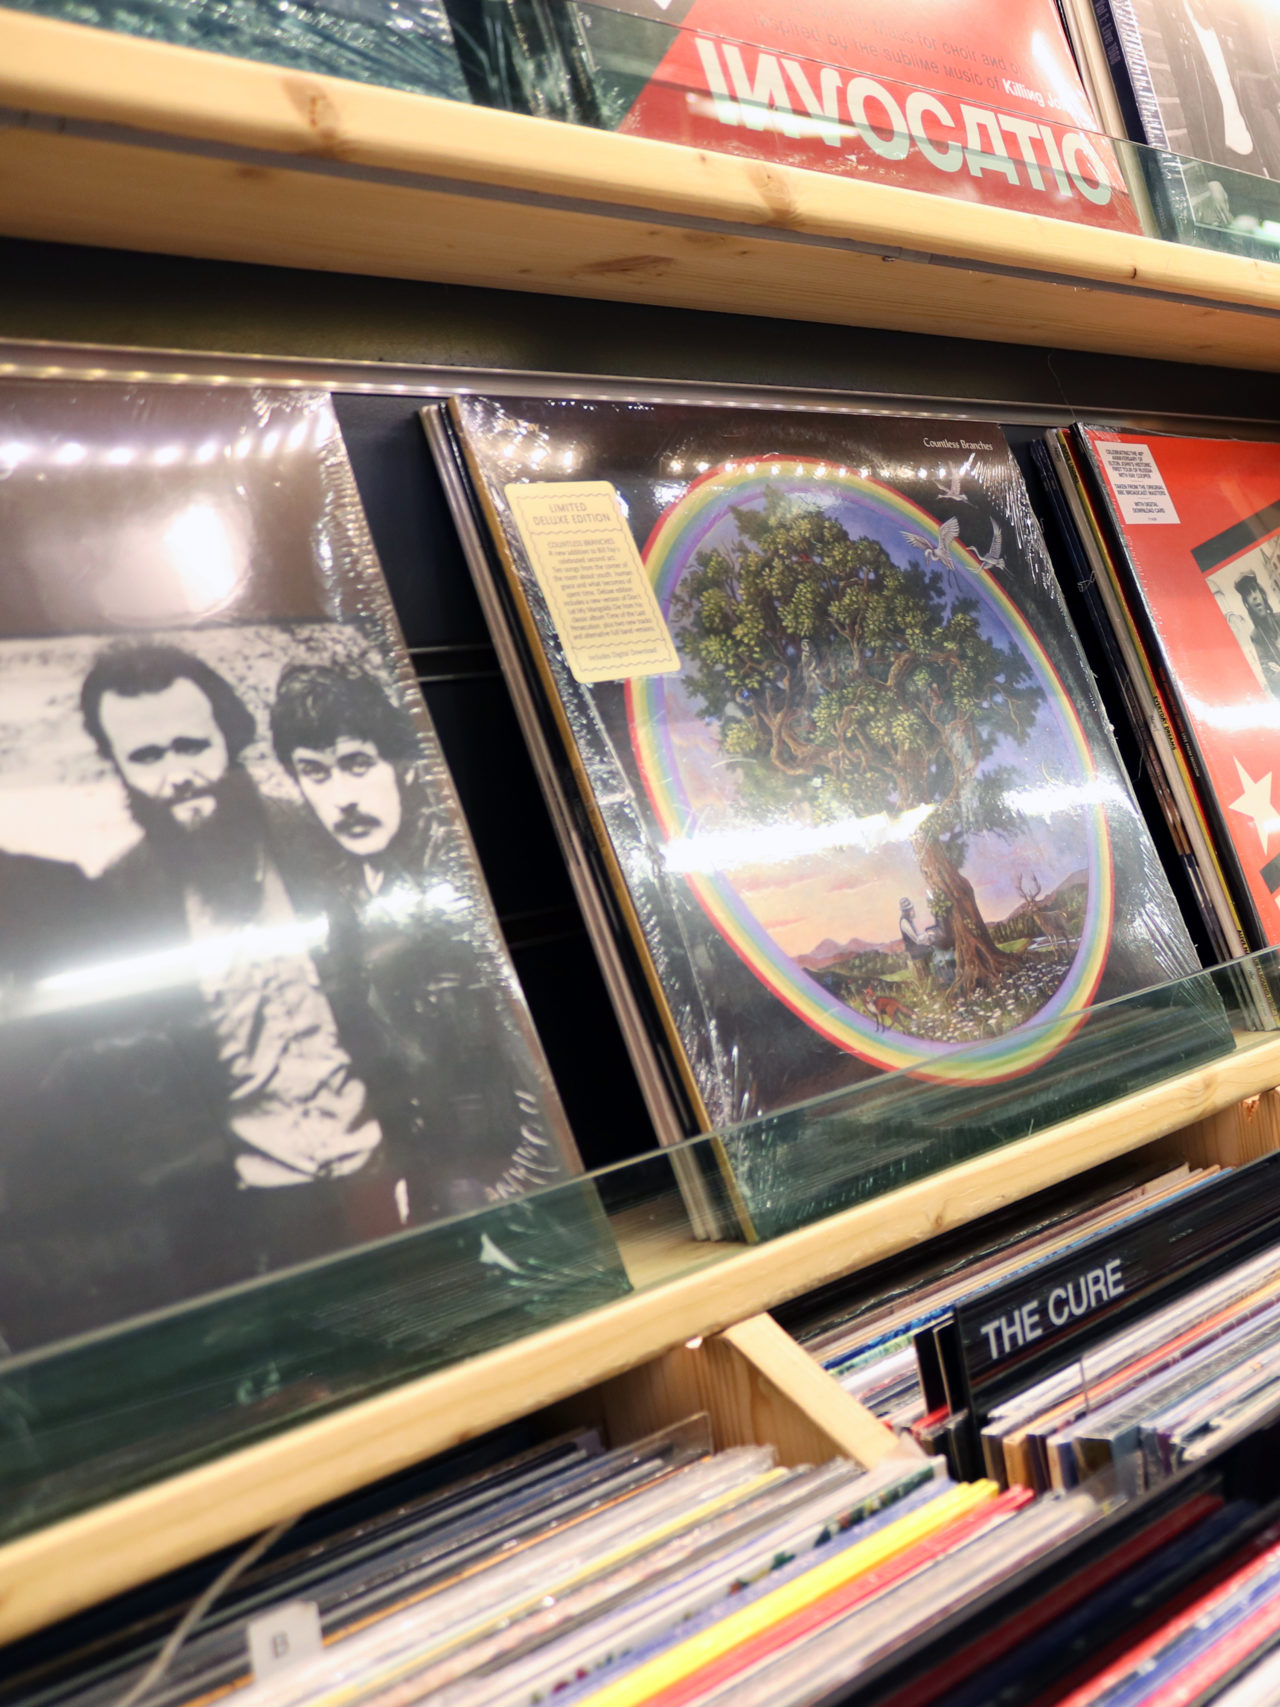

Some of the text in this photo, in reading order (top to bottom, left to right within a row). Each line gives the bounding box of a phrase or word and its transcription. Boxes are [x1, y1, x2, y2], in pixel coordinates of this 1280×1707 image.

[923, 438, 993, 450] Countless Branches
[549, 502, 587, 513] LIMITED
[533, 513, 611, 526] DELUXE EDITION
[1154, 695, 1167, 725] EVERYDAY
[1164, 725, 1176, 751] DREAMS
[981, 1258, 1126, 1361] THE CURE
